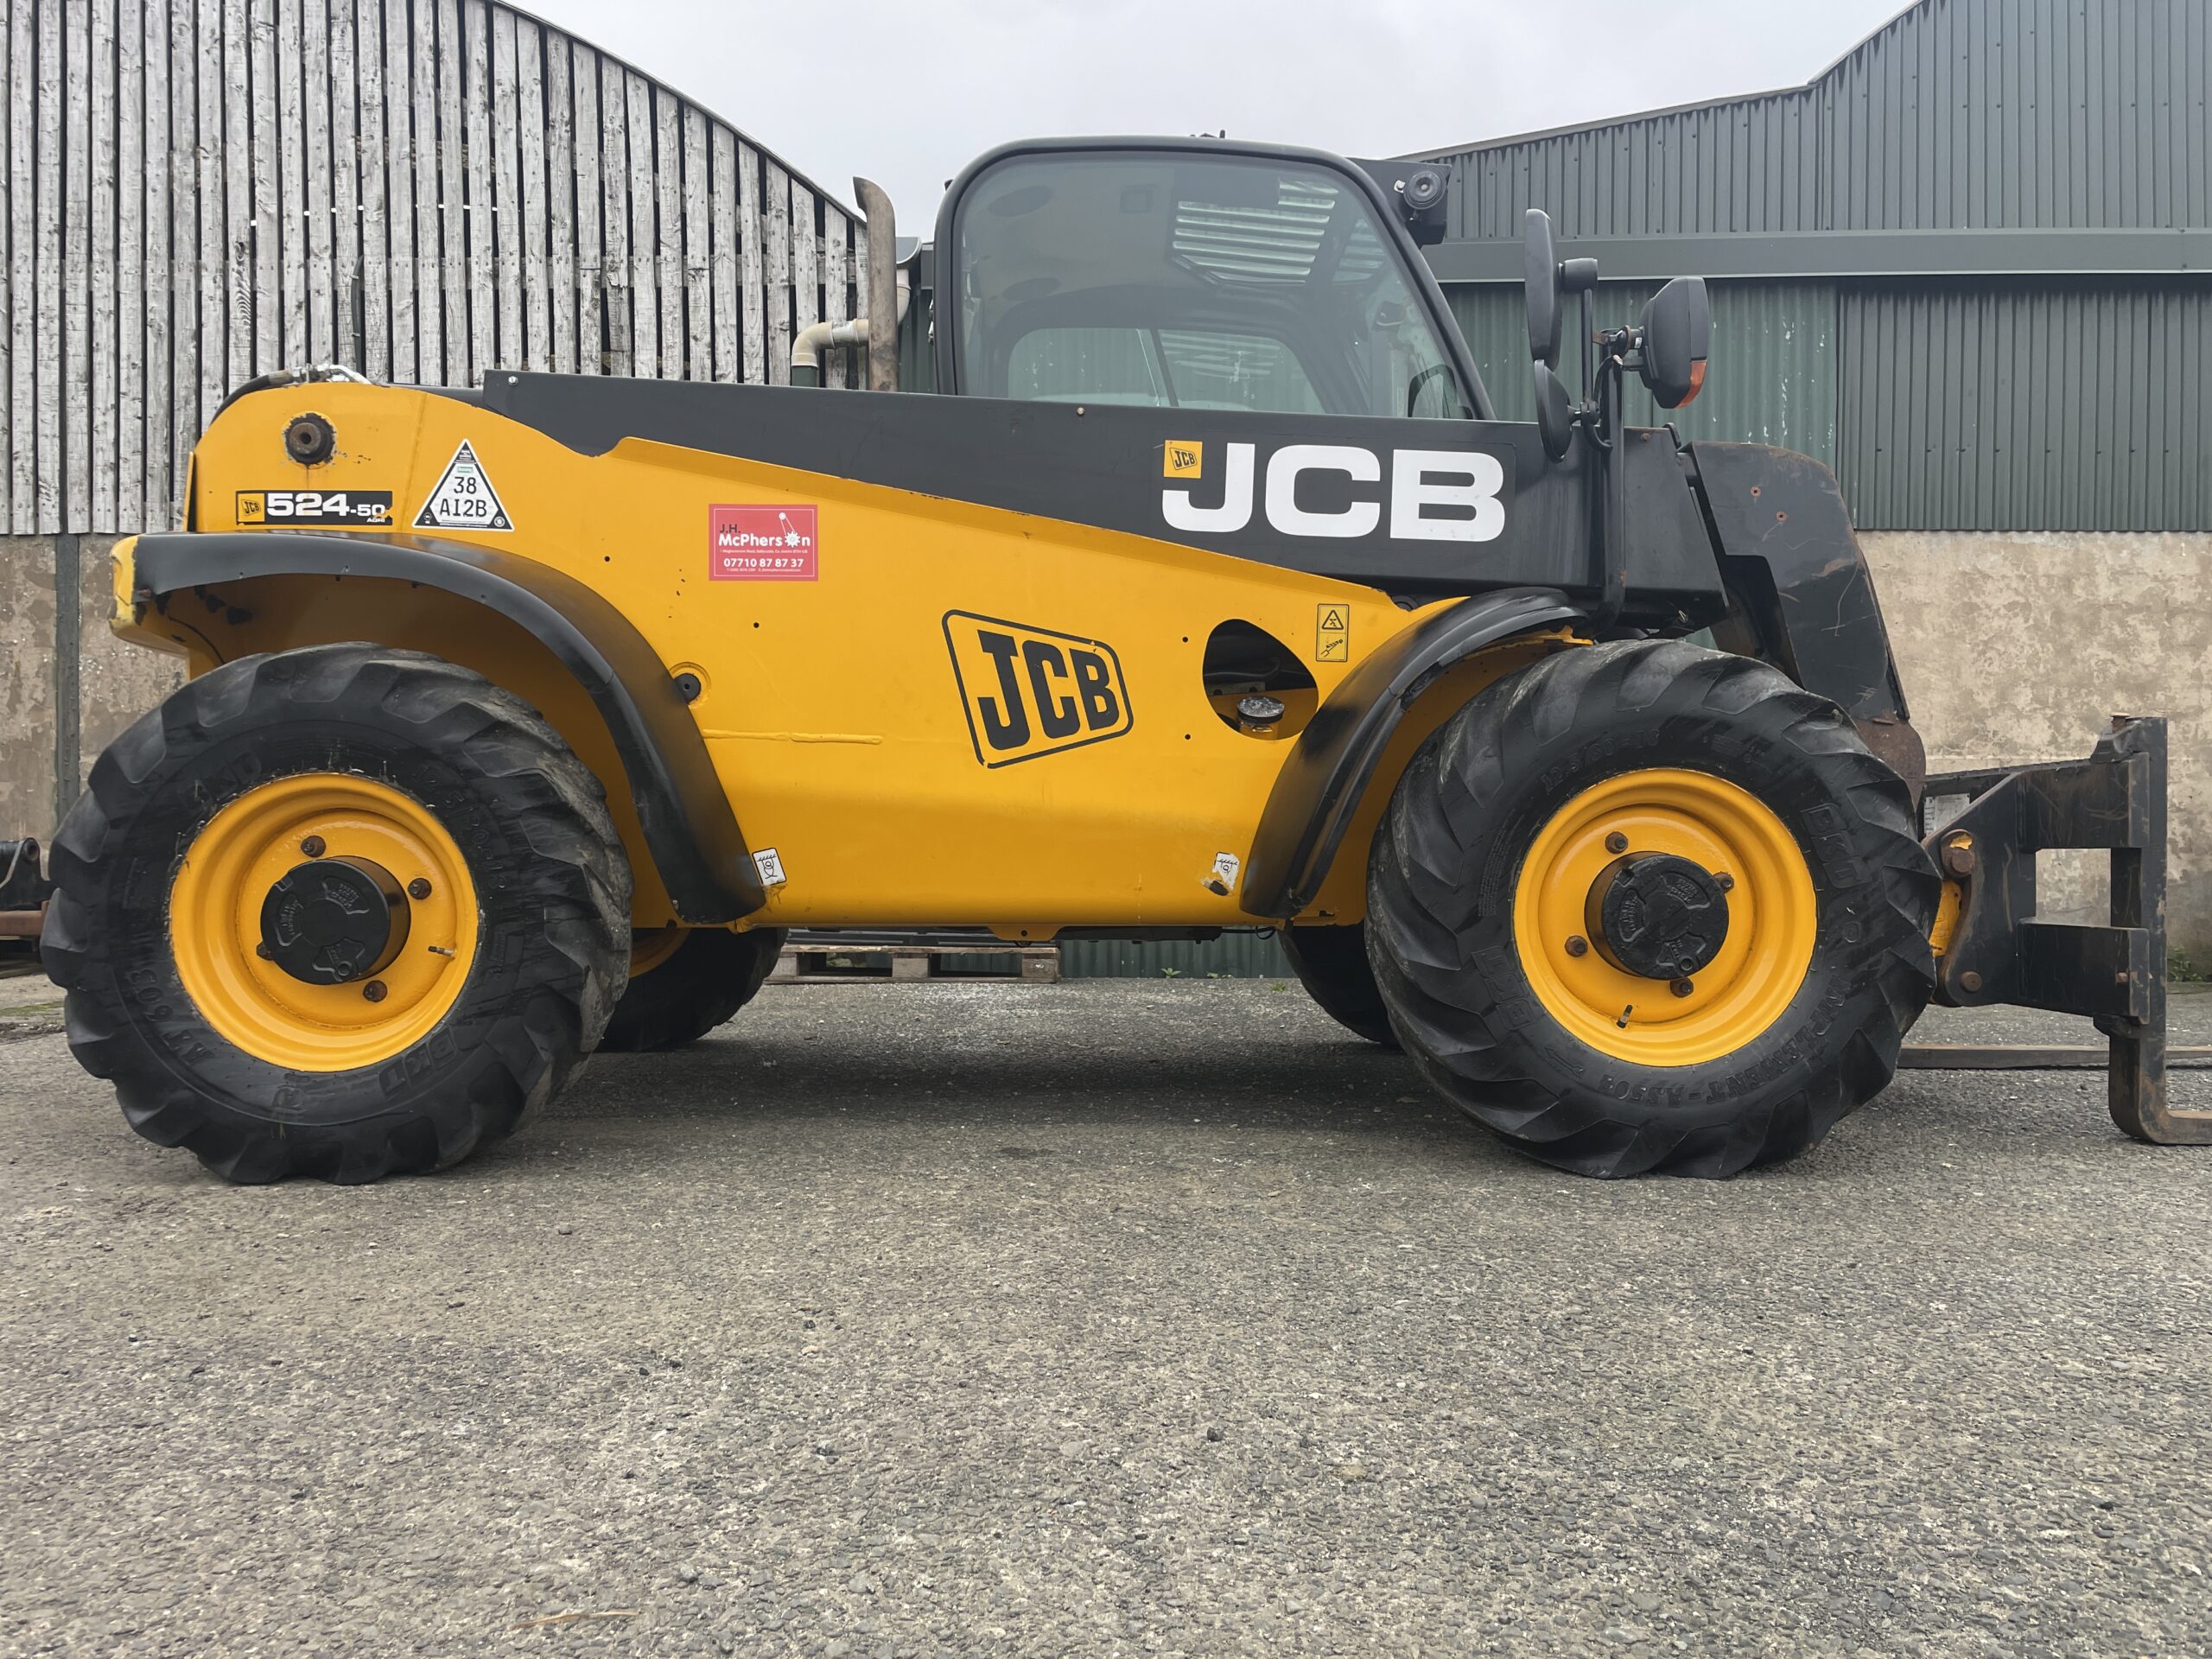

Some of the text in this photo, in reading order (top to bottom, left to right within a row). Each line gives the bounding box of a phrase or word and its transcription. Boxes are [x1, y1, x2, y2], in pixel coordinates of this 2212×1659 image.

[1175, 449, 1195, 467] JCB
[454, 477, 477, 494] 38
[1161, 442, 1506, 543] JCB
[244, 500, 260, 514] JCB
[719, 524, 741, 533] J.H.
[723, 558, 804, 568] 07710 87 87 37
[976, 629, 1120, 751] JCB
